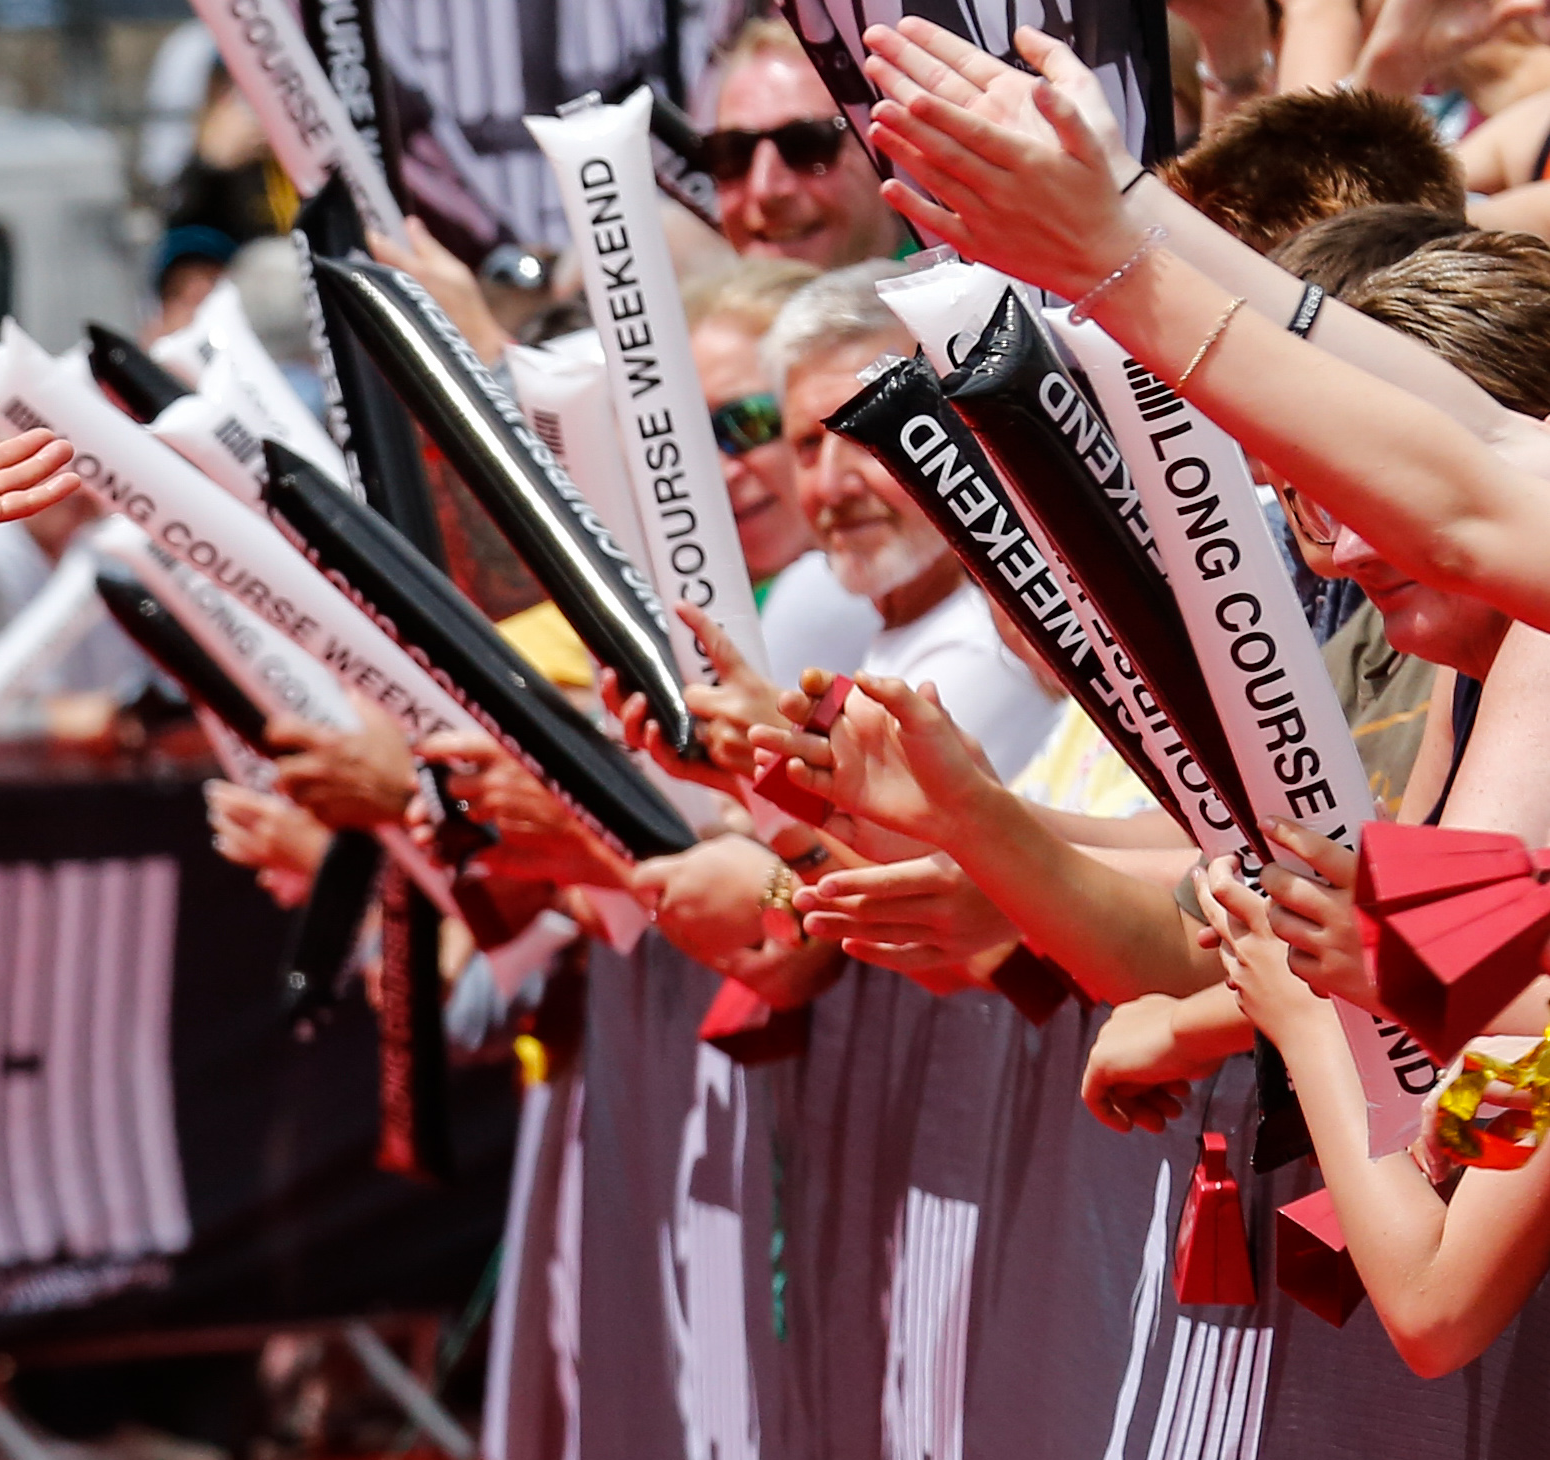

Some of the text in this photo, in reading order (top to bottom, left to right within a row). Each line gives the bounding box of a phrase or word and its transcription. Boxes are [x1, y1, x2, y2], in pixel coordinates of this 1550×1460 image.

[580, 157, 662, 399] WEEKEND
[69, 449, 158, 525] ONG
[161, 520, 321, 649] COURSE
[638, 407, 716, 609] COURSE
[899, 414, 1094, 667] WEEKEND
[1149, 421, 1337, 819] LONG COURSE
